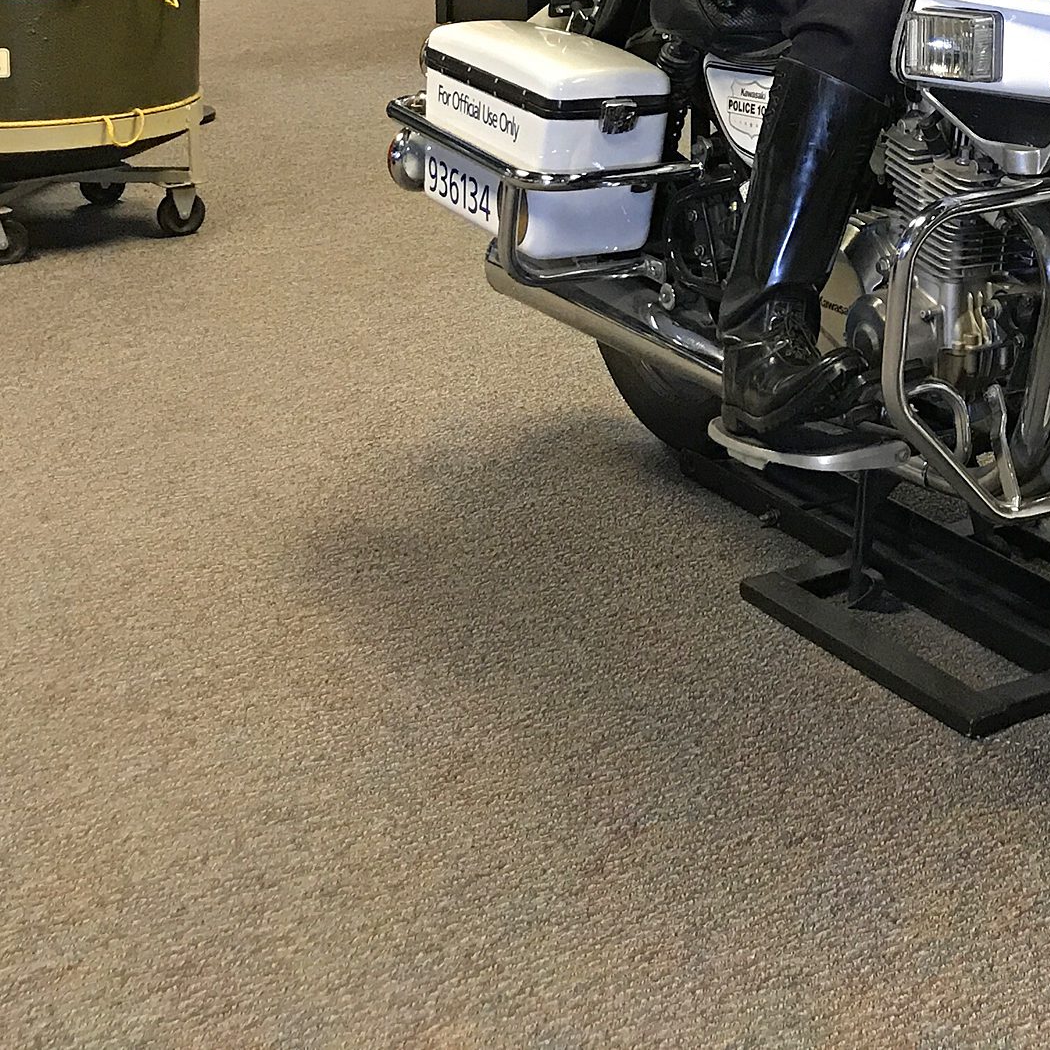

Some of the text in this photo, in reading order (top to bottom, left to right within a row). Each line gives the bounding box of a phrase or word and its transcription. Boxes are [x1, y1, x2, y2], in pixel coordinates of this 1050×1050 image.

[729, 99, 756, 115] POLICE
[741, 88, 767, 101] Kawasaki
[438, 85, 520, 143] For Official Use Only
[428, 156, 491, 221] 936134
